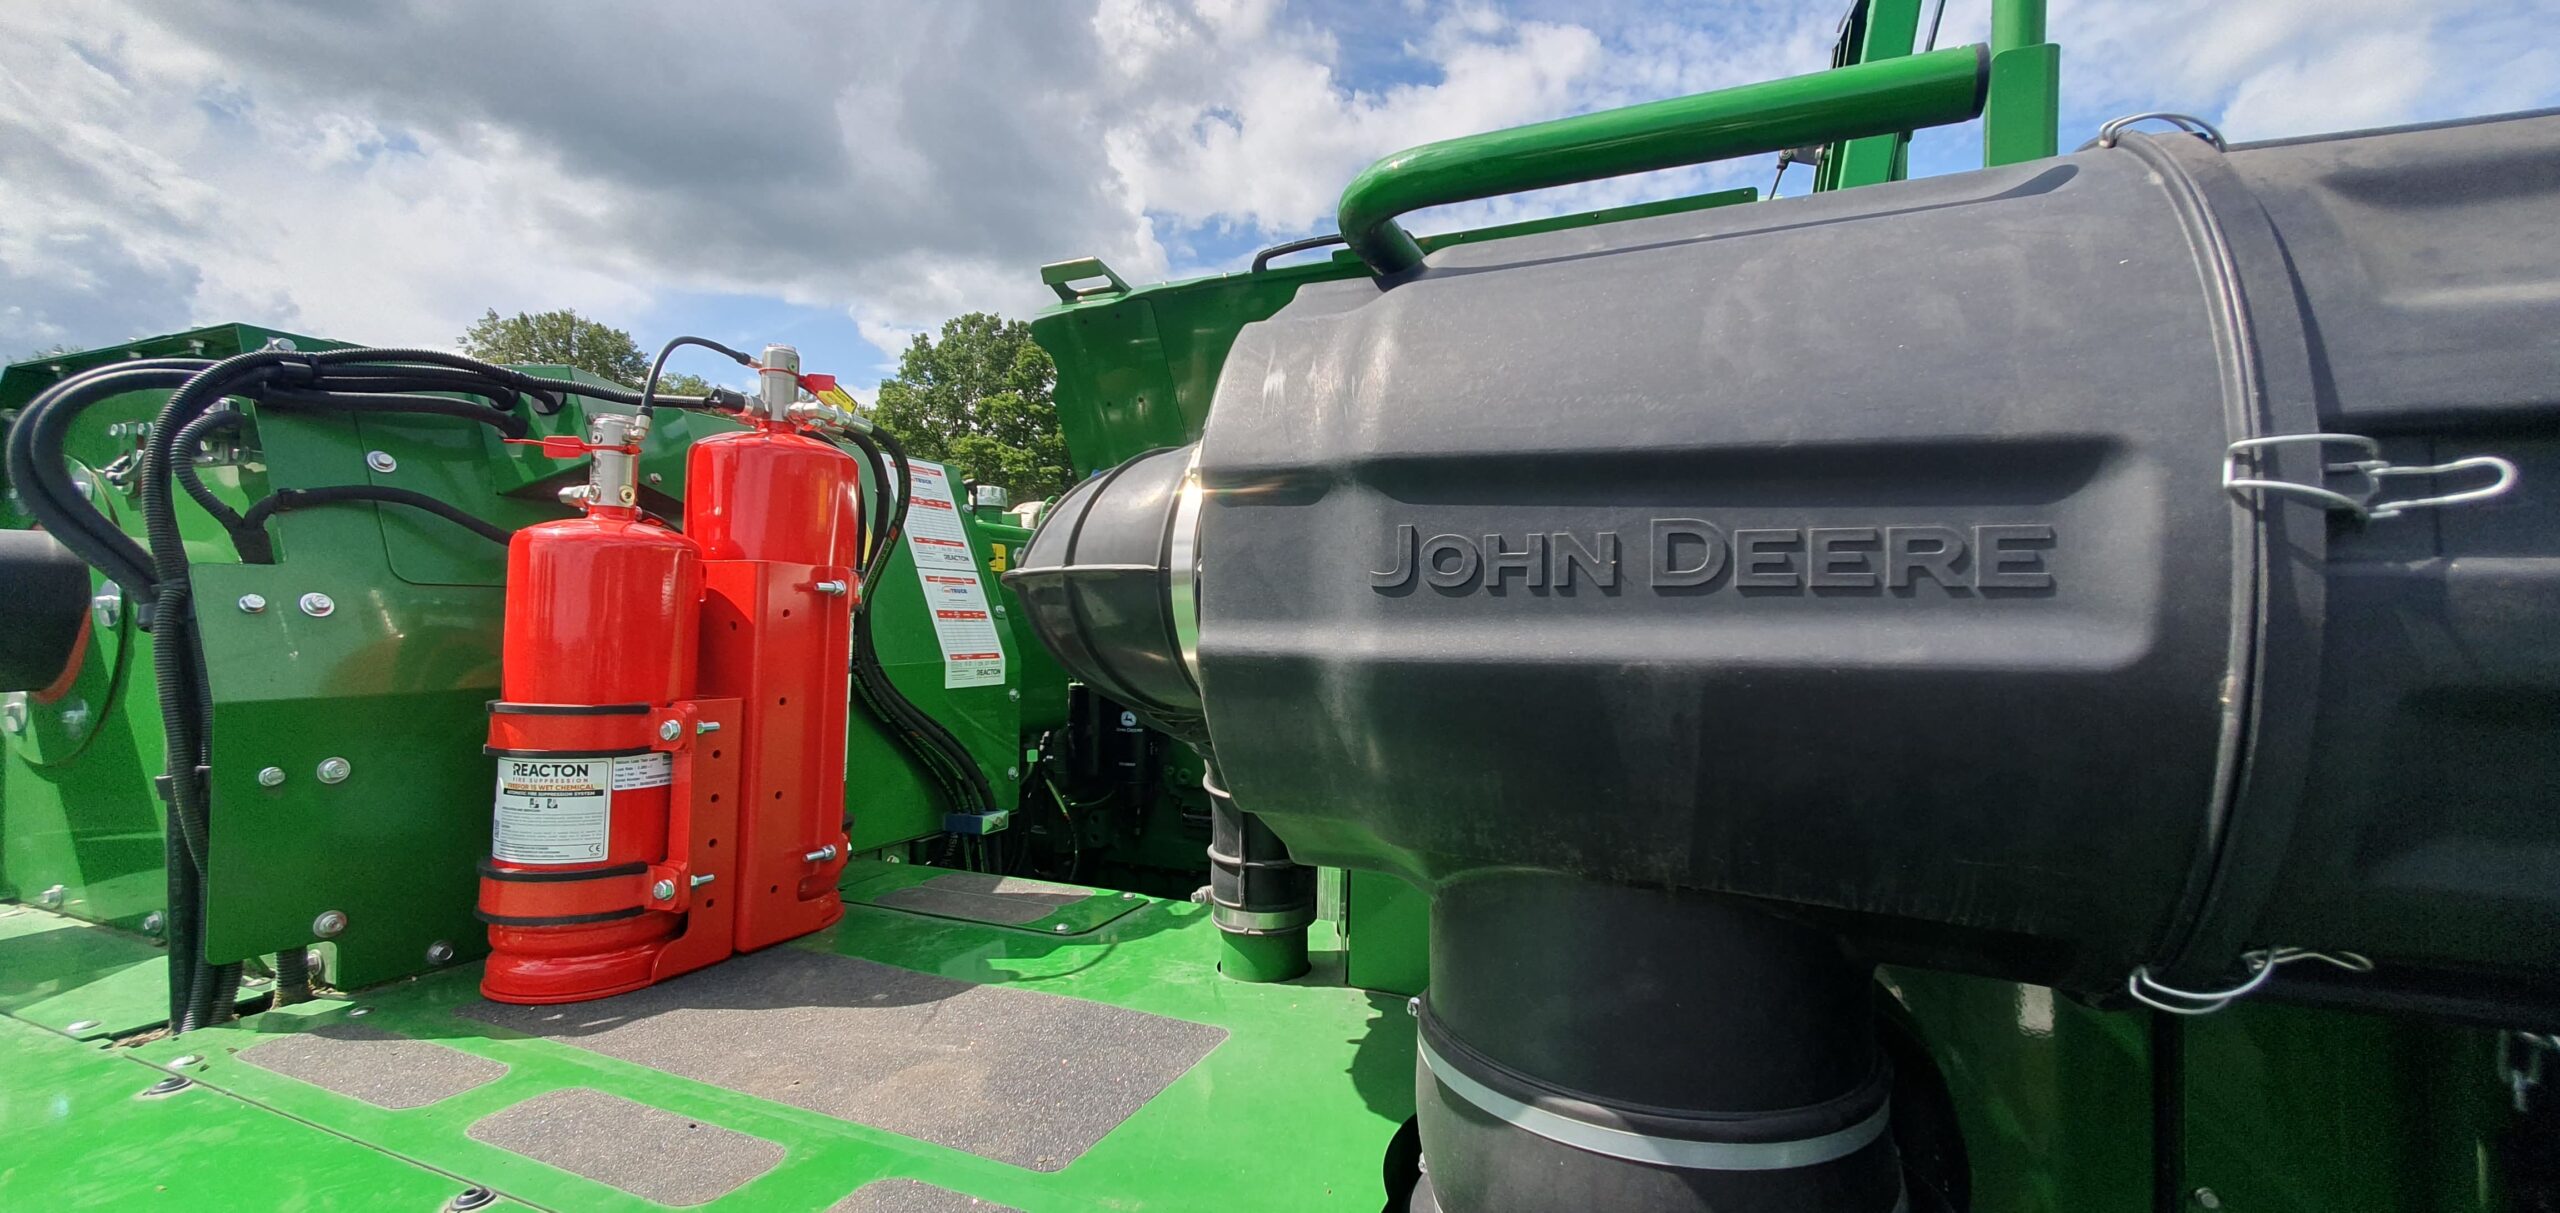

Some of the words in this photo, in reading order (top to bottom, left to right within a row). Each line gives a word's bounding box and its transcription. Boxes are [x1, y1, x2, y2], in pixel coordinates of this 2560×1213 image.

[1368, 524, 1621, 596] JOHN
[1650, 517, 2057, 597] DEERE
[513, 763, 589, 777] REACTON
